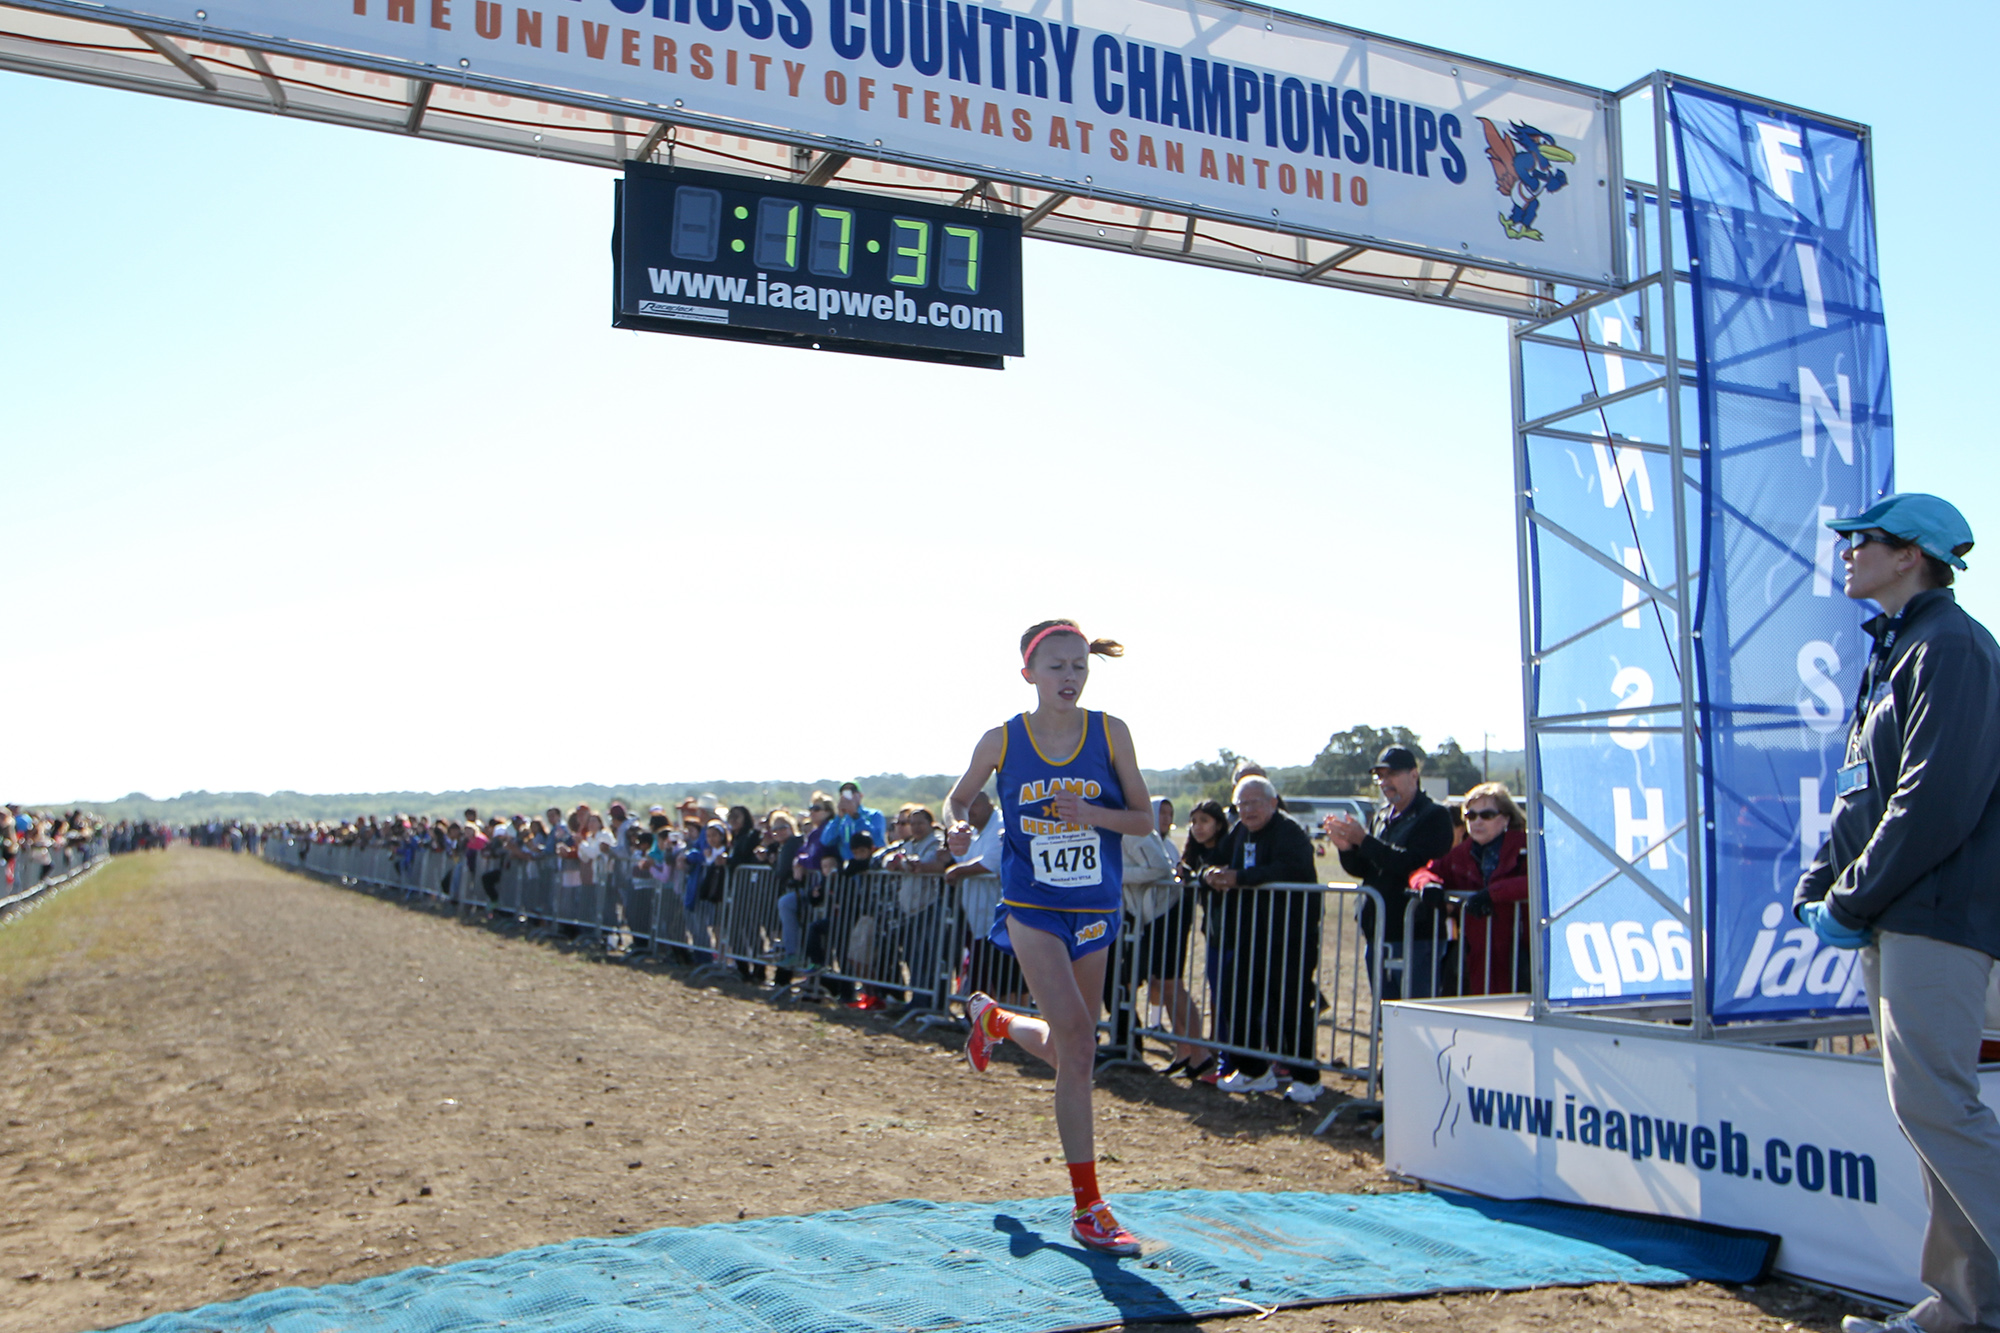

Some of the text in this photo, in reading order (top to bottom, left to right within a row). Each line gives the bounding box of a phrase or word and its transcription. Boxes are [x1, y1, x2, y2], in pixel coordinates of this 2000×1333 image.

[474, 0, 806, 97] UNIVERSITY
[824, 70, 876, 111] OF
[893, 83, 1033, 142] TEXAS
[1048, 116, 1094, 154] AT
[1109, 128, 1184, 172] SAN
[1199, 147, 1369, 206] ANTONIO
[830, 0, 1468, 185] COUNTRY CHAMPIONSHIPS
[648, 267, 1003, 333] www.iaapweb.com
[1019, 778, 1102, 805] ALAMO
[1039, 845, 1097, 873] 1478
[1467, 1085, 1877, 1204] www.iaapweb.com
